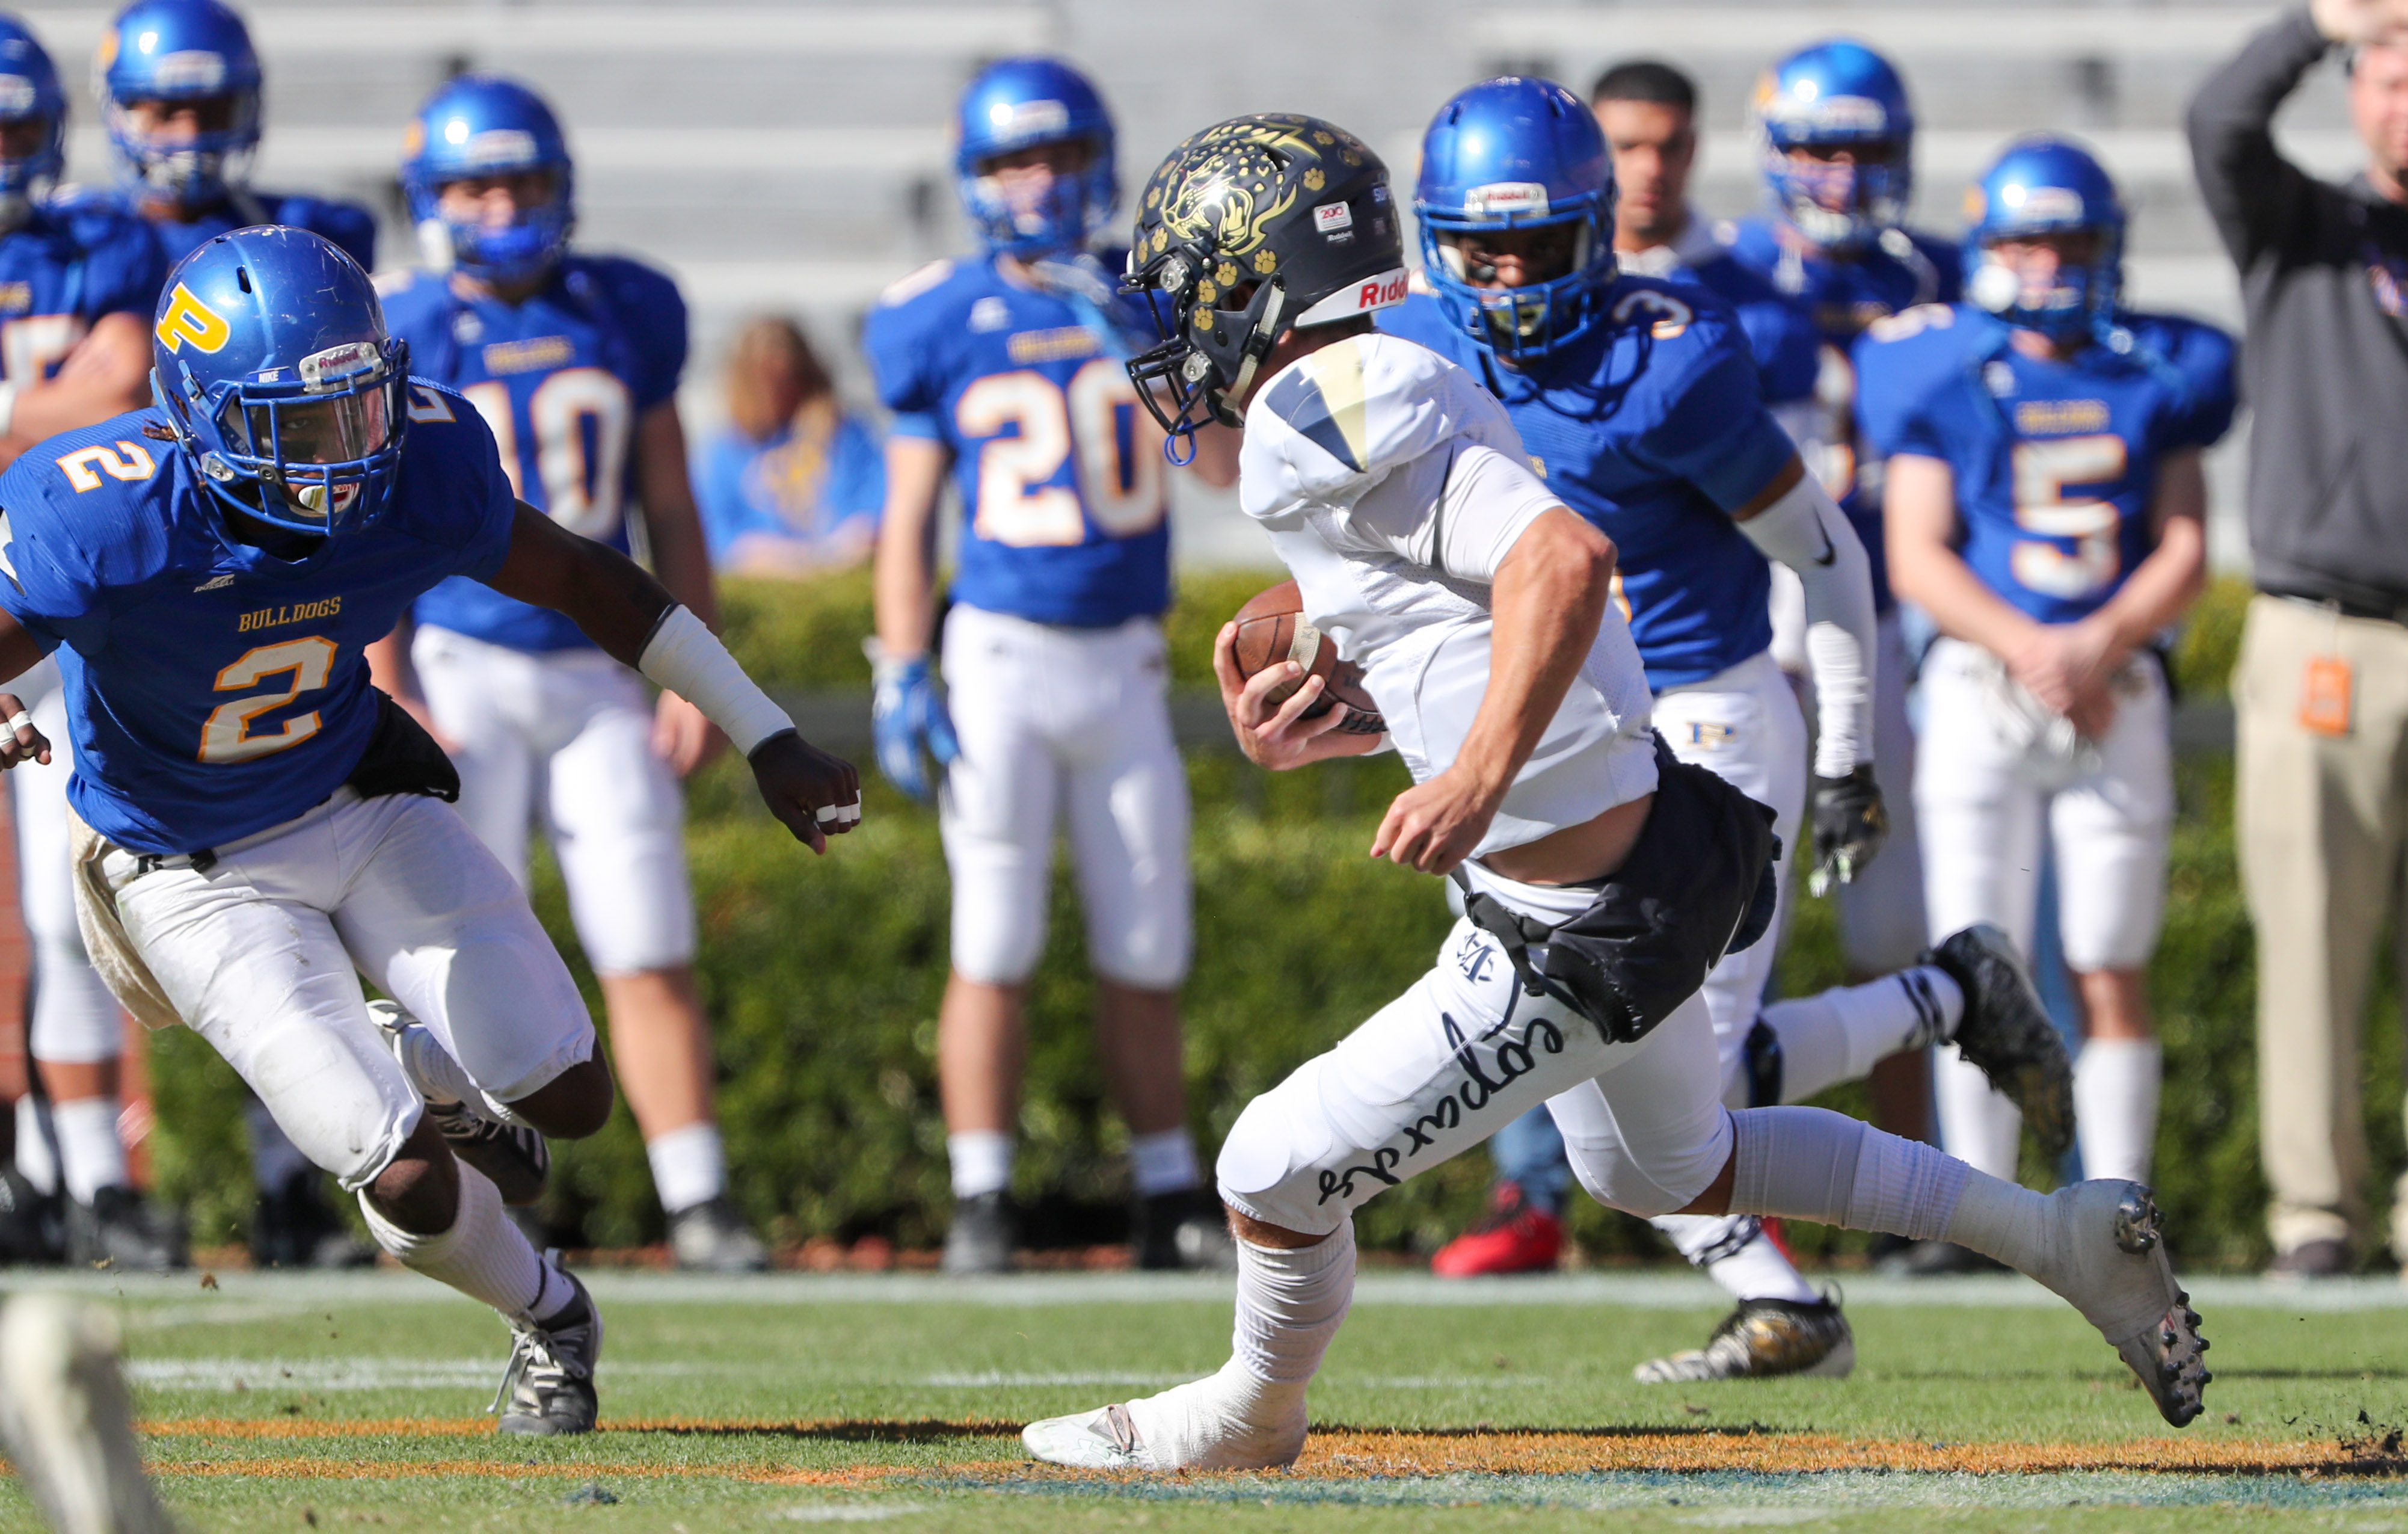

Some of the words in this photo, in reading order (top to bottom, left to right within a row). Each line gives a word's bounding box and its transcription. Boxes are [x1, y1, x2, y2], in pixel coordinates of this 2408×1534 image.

[1320, 206, 1345, 219] 200
[1327, 230, 1353, 242] Riddell
[1359, 274, 1408, 309] Ridd
[155, 282, 232, 355] P
[318, 347, 359, 369] Riddell
[258, 370, 279, 383] NIKE
[55, 440, 156, 493] 2
[956, 359, 1168, 548] 20
[2010, 433, 2128, 602] 5
[193, 579, 235, 593] RUSSELL
[238, 596, 342, 632] BULLDOGS
[197, 635, 339, 764] 2
